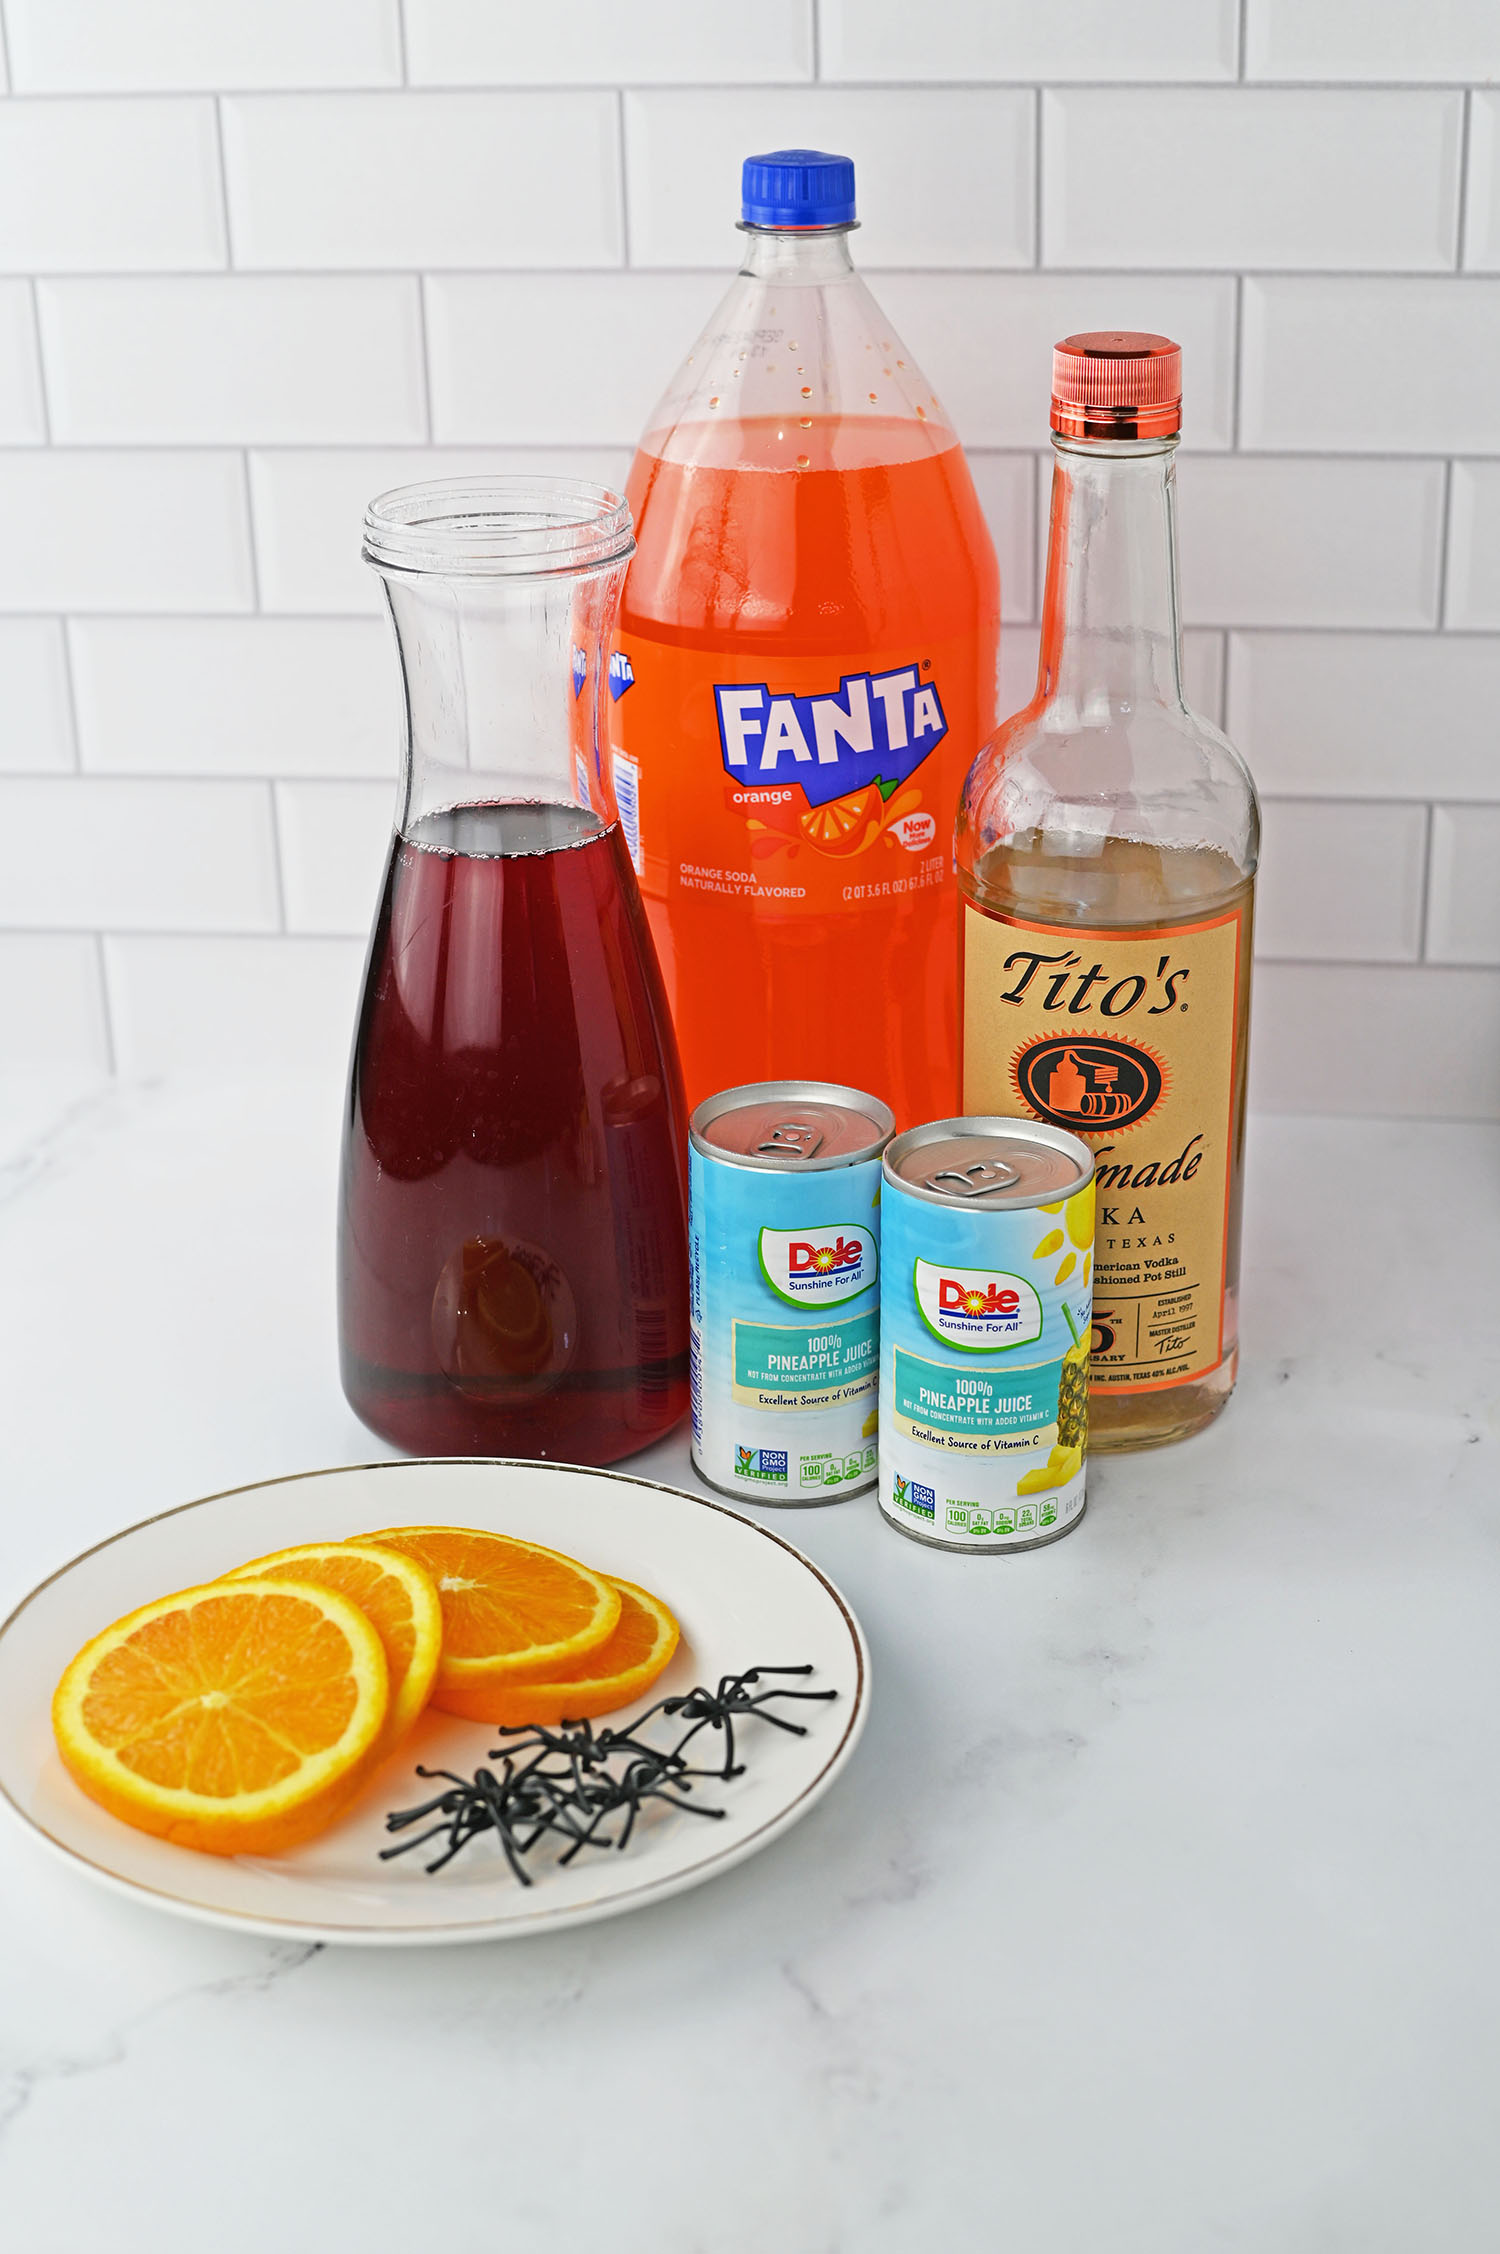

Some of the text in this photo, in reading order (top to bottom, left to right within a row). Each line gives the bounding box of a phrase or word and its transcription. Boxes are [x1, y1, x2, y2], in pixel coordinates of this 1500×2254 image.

[719, 670, 943, 770] FANTA
[733, 791, 792, 805] orange
[903, 819, 931, 834] Now
[926, 856, 944, 871] LITER
[680, 863, 757, 884] ORANGE SODA
[680, 875, 806, 898] NATURALLY FLAVORED
[854, 885, 865, 898] QT
[867, 883, 880, 897] 3.6
[882, 882, 891, 895] FL
[892, 879, 907, 893] OZ)
[1000, 950, 1190, 1019] Tito's
[1094, 1133, 1204, 1191] made
[1106, 1233, 1175, 1249] TEXAS
[789, 1236, 863, 1273] Dole
[1144, 1256, 1179, 1269] Vodka
[1143, 1273, 1162, 1283] Pot
[1164, 1266, 1186, 1279] Still
[789, 1280, 833, 1291] Sunshine
[835, 1276, 849, 1286] For
[939, 1278, 1020, 1316] Dole
[1157, 1293, 1192, 1306] ESTABLISHED
[1152, 1302, 1194, 1319] April 1997
[939, 1318, 984, 1332] Sunshine
[986, 1323, 1003, 1332] For
[1149, 1321, 1196, 1337] MASTER DISTILLER
[808, 1334, 842, 1353] 100%
[1154, 1335, 1191, 1355] Tito
[768, 1339, 873, 1371] PINEAPPLE JUICE
[747, 1369, 759, 1379] NOT
[761, 1372, 779, 1382] FROM
[781, 1371, 826, 1383] CONCENTRATE
[828, 1369, 843, 1379] WITH
[844, 1363, 862, 1375] ADDED
[1133, 1371, 1151, 1380] TEXAS
[759, 1375, 878, 1406] Excellent Source of Vitamin C
[956, 1379, 993, 1397] 100%
[919, 1387, 1032, 1414] PINEAPPLE JUICE
[903, 1399, 1050, 1426] NOT FROM CONCENTRATE WITH ADDED VITAMIN C
[911, 1425, 1040, 1450] Excellent Source of Vitamin C
[762, 1451, 786, 1460] NON
[762, 1458, 786, 1467] GMO
[811, 1452, 833, 1460] SERVING
[736, 1467, 786, 1480] VERIFIED
[803, 1465, 820, 1476] 100
[913, 1484, 933, 1497] NON
[913, 1491, 934, 1505] GMO
[894, 1496, 933, 1518] VERIFIED
[949, 1510, 966, 1522] 100
